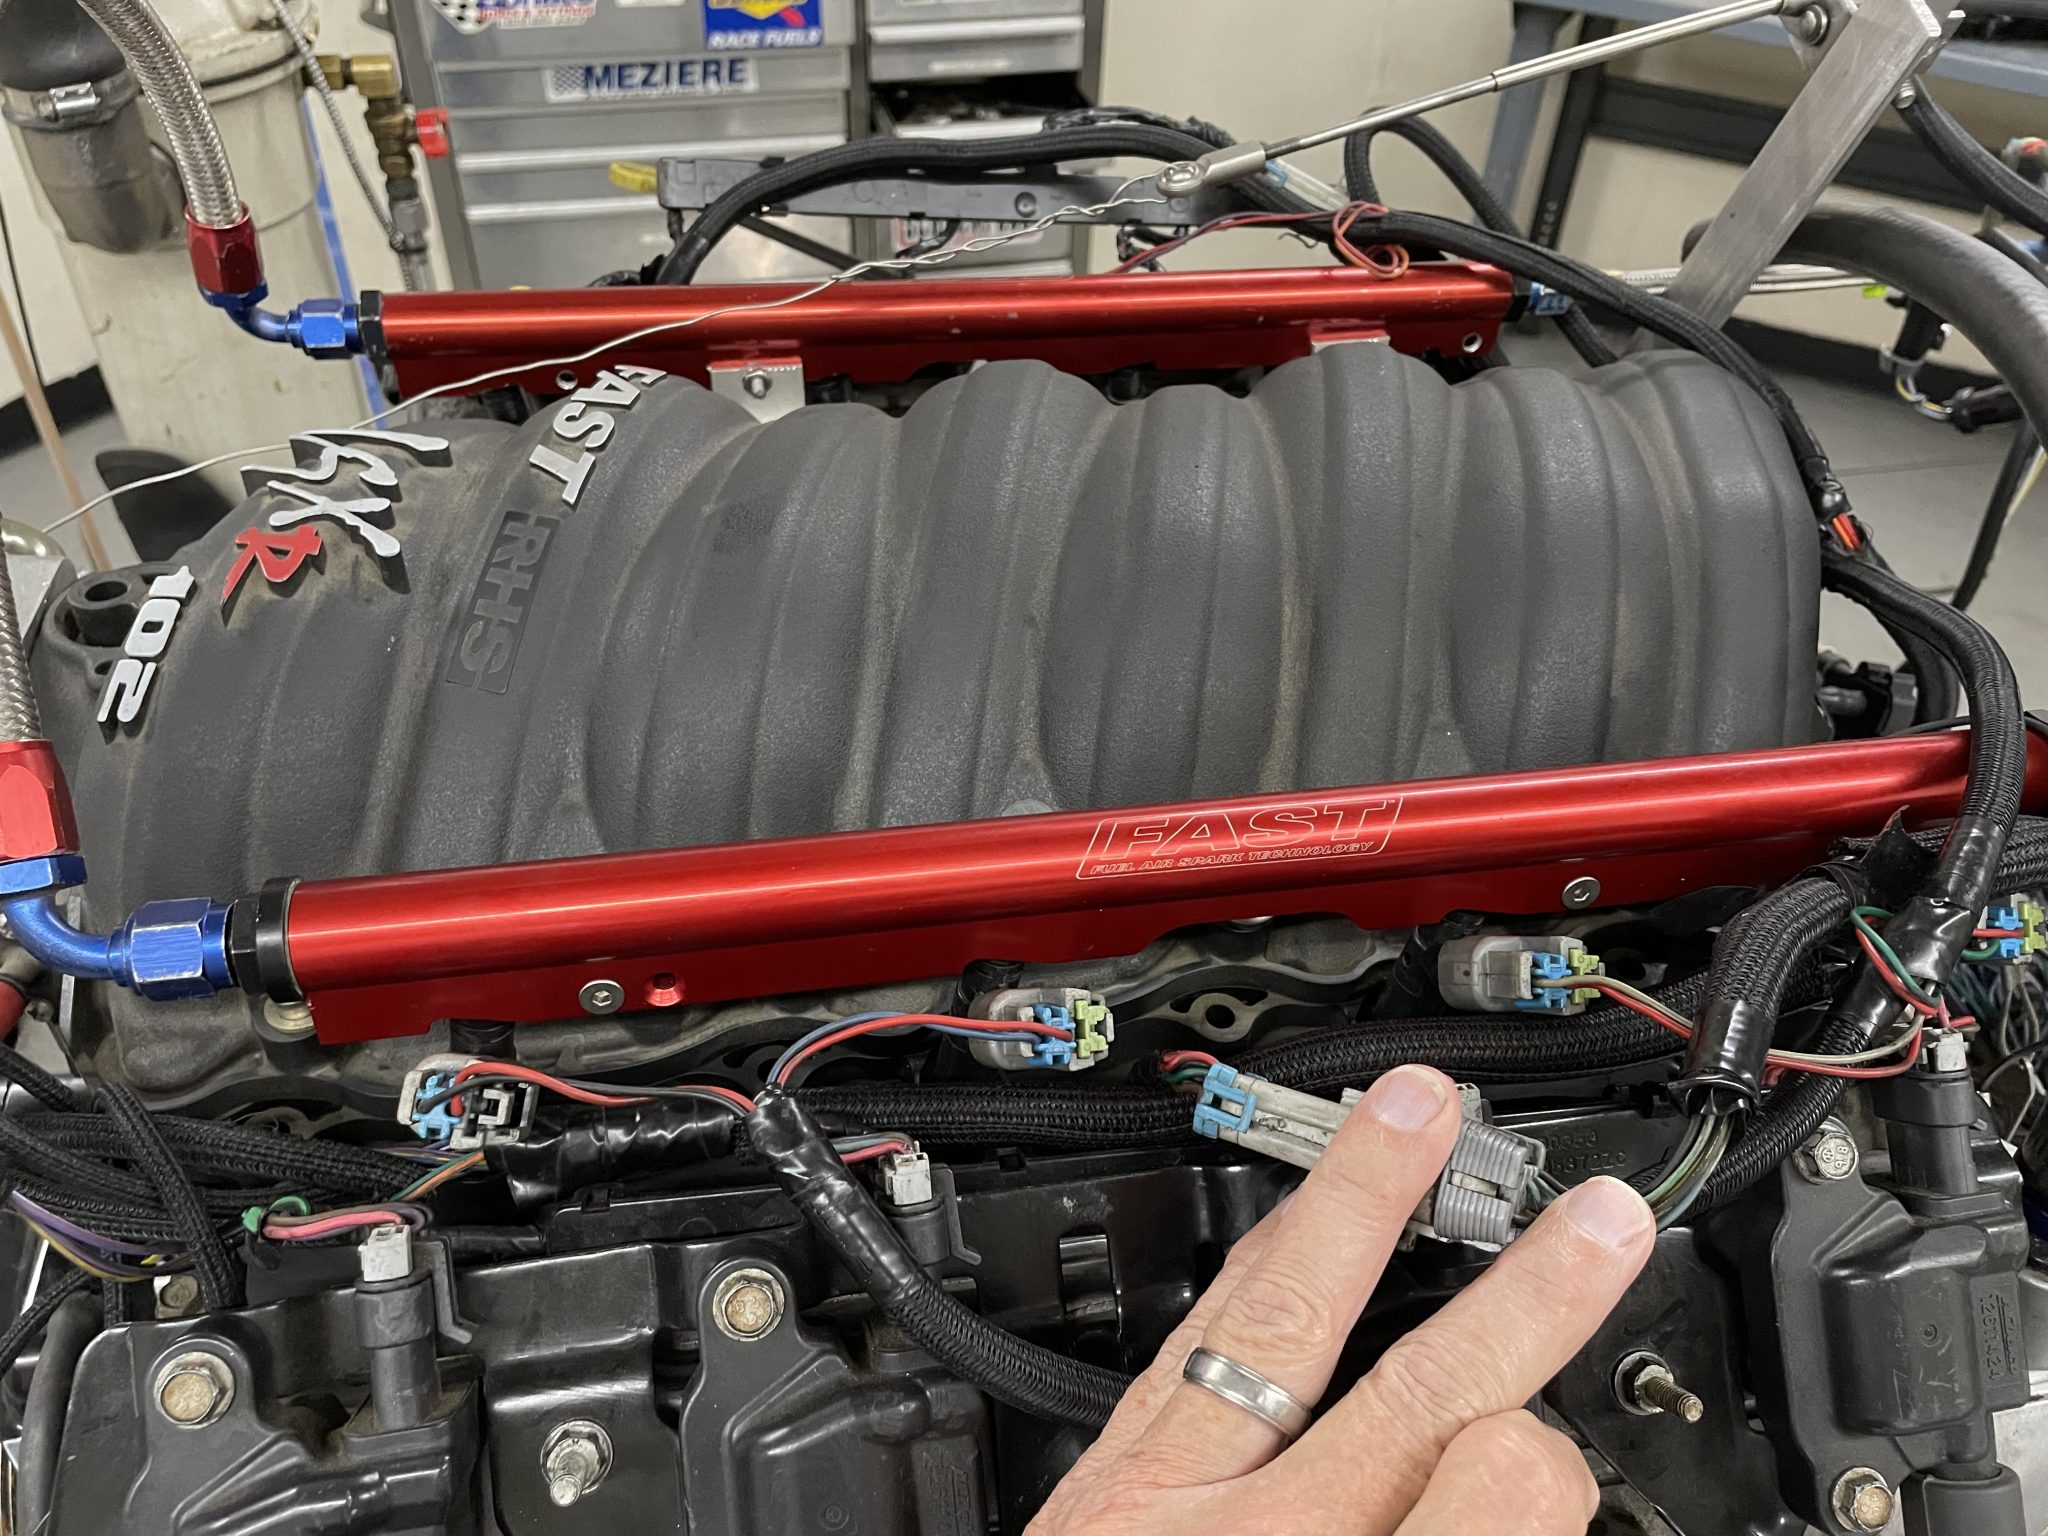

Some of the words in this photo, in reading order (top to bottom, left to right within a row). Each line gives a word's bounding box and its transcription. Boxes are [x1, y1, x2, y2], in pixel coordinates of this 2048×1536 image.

[710, 32, 760, 49] RACE
[765, 29, 821, 47] FUELS
[583, 58, 748, 91] MEZIERE
[528, 364, 668, 506] FAST
[459, 520, 551, 675] RHS
[96, 565, 195, 724] 102
[1089, 862, 1136, 875] FUEL
[1138, 858, 1175, 872] AIR
[1177, 852, 1245, 869] SPARK
[1248, 841, 1376, 861] TECHNOLOGY
[1101, 799, 1388, 862] FAST
